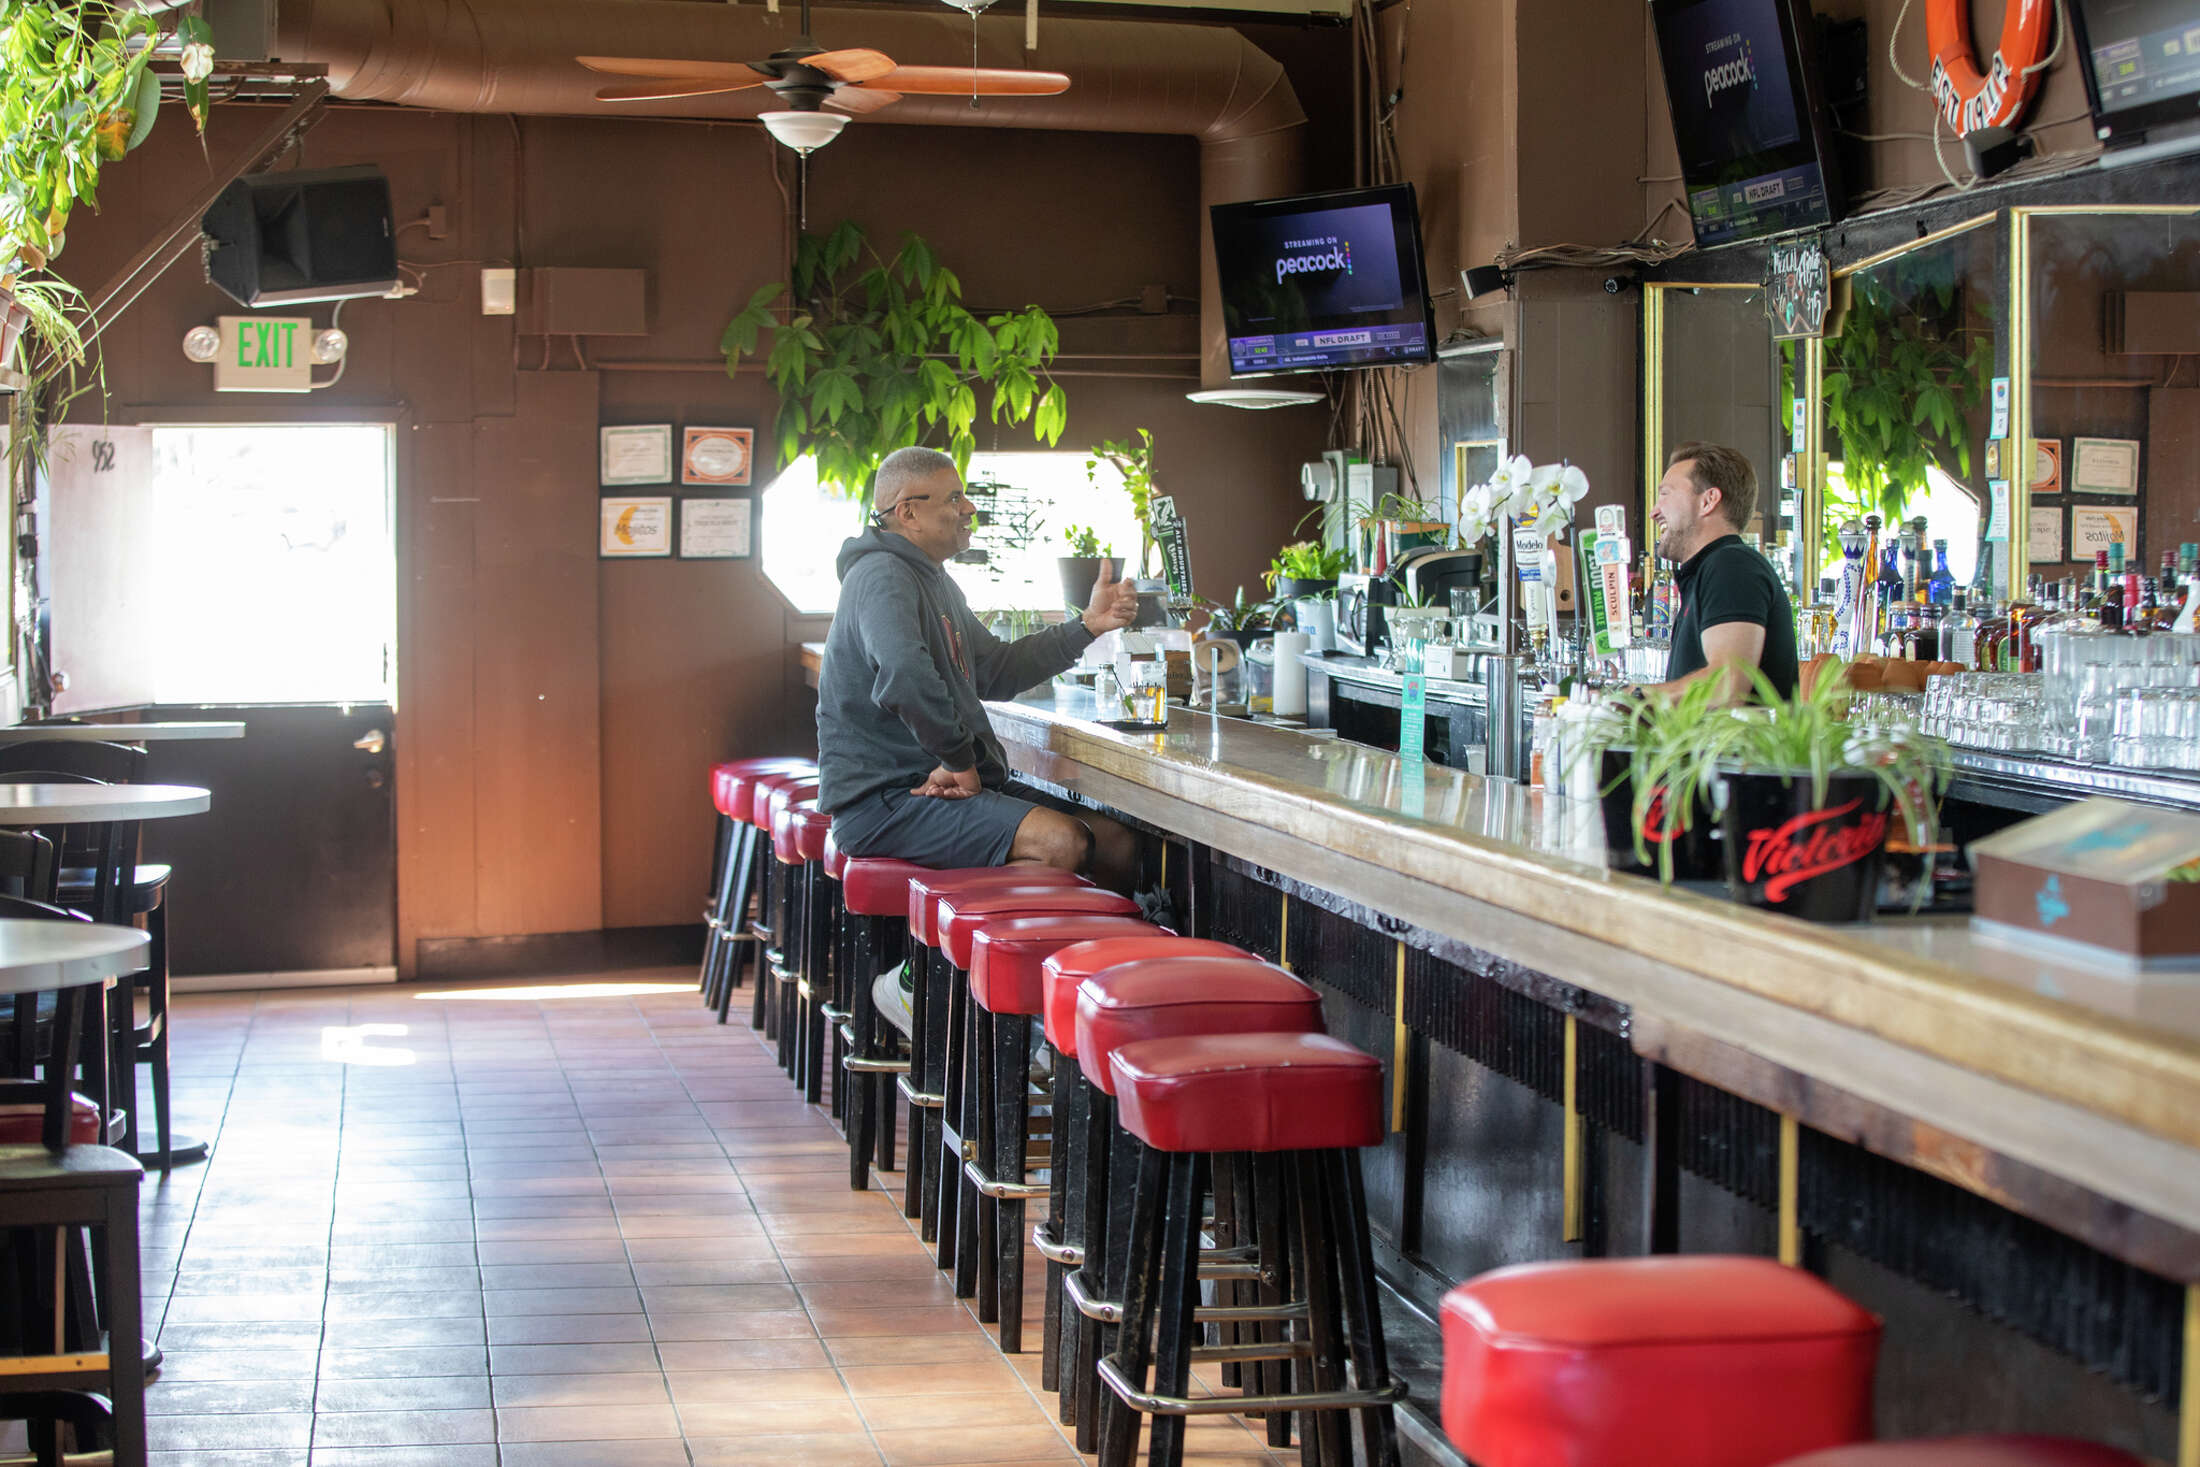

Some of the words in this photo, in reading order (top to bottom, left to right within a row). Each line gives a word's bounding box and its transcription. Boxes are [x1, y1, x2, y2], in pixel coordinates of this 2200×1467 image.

[1705, 34, 1732, 54] STREAMING
[1704, 47, 1752, 109] peacock
[1284, 236, 1325, 249] STREAMING
[1327, 236, 1337, 244] ON
[1276, 247, 1346, 285] peacock
[238, 322, 298, 367] EXIT
[1319, 335, 1336, 345] NFL
[1338, 333, 1367, 345] DRAFT
[1516, 539, 1543, 550] Modelo
[1607, 572, 1618, 616] SCULPIN
